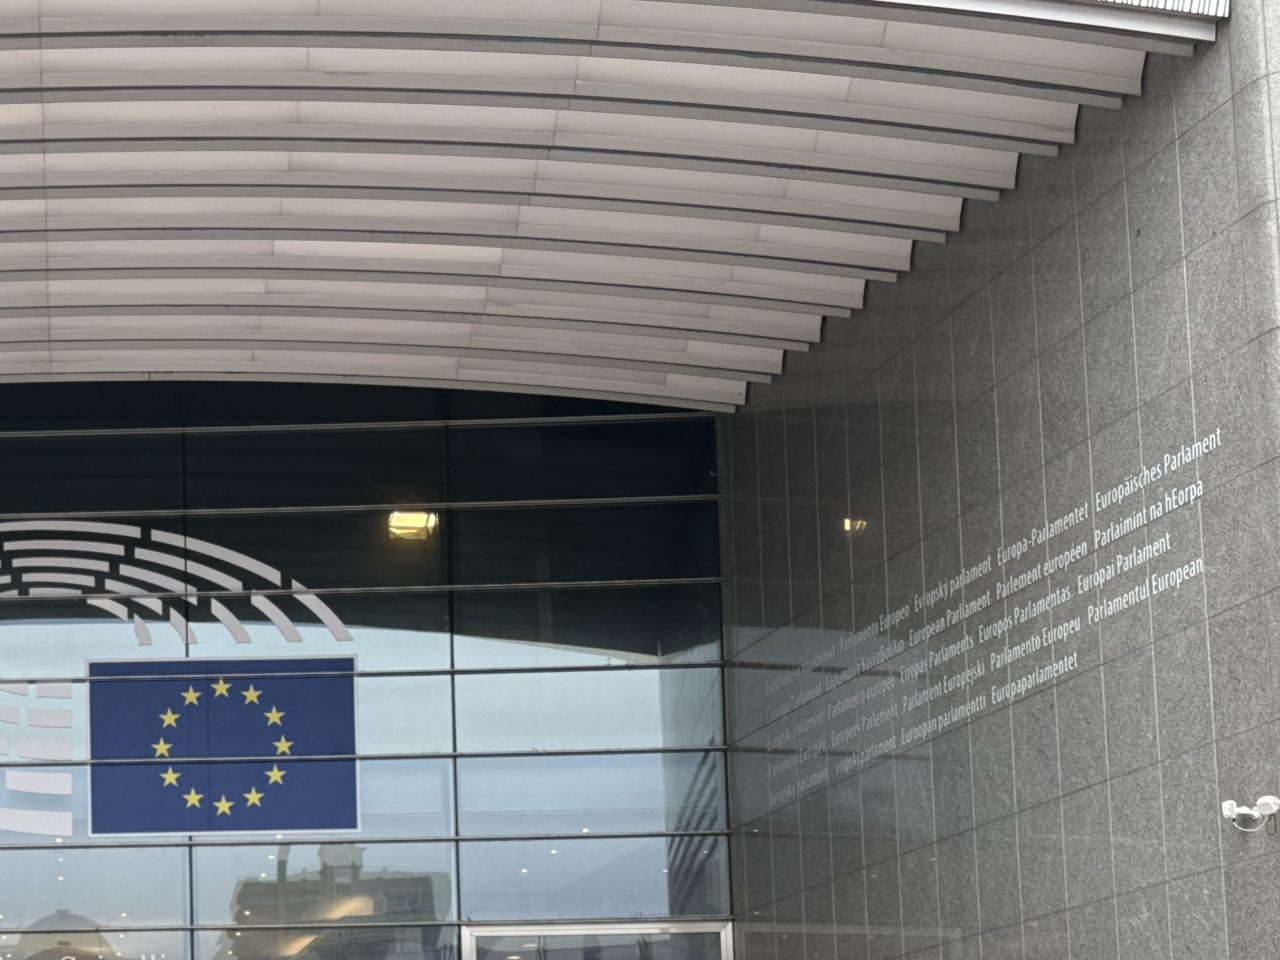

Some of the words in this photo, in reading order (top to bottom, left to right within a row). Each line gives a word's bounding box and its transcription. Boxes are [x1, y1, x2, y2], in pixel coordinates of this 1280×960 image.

[880, 604, 910, 632] Europeo
[950, 556, 992, 597] parlament
[997, 501, 1089, 566] Europa-Parlamentet
[1096, 463, 1162, 512] Europäisches
[1164, 427, 1221, 475] Parlament
[909, 611, 945, 647] European
[946, 590, 991, 627] Parliament
[996, 563, 1042, 600] Parlement
[1043, 541, 1088, 576] européen
[1094, 509, 1147, 549] Parlaimint
[1149, 500, 1163, 520] na
[1165, 479, 1204, 513] hEorpa
[929, 634, 974, 669] Parlaments
[978, 611, 1013, 644] Europos
[1014, 586, 1071, 624] Parlamentas
[1116, 532, 1171, 575] Parlament
[901, 717, 937, 745] Euroopan
[939, 692, 986, 733] parlamentti
[991, 651, 1078, 704] Europaparlamentet
[903, 678, 942, 713] Parlament
[943, 657, 985, 694] Europejski
[990, 634, 1040, 671] Parlamento
[1042, 616, 1081, 646] Europeu
[1088, 577, 1150, 626] Parlamentul
[1152, 557, 1203, 596] European
